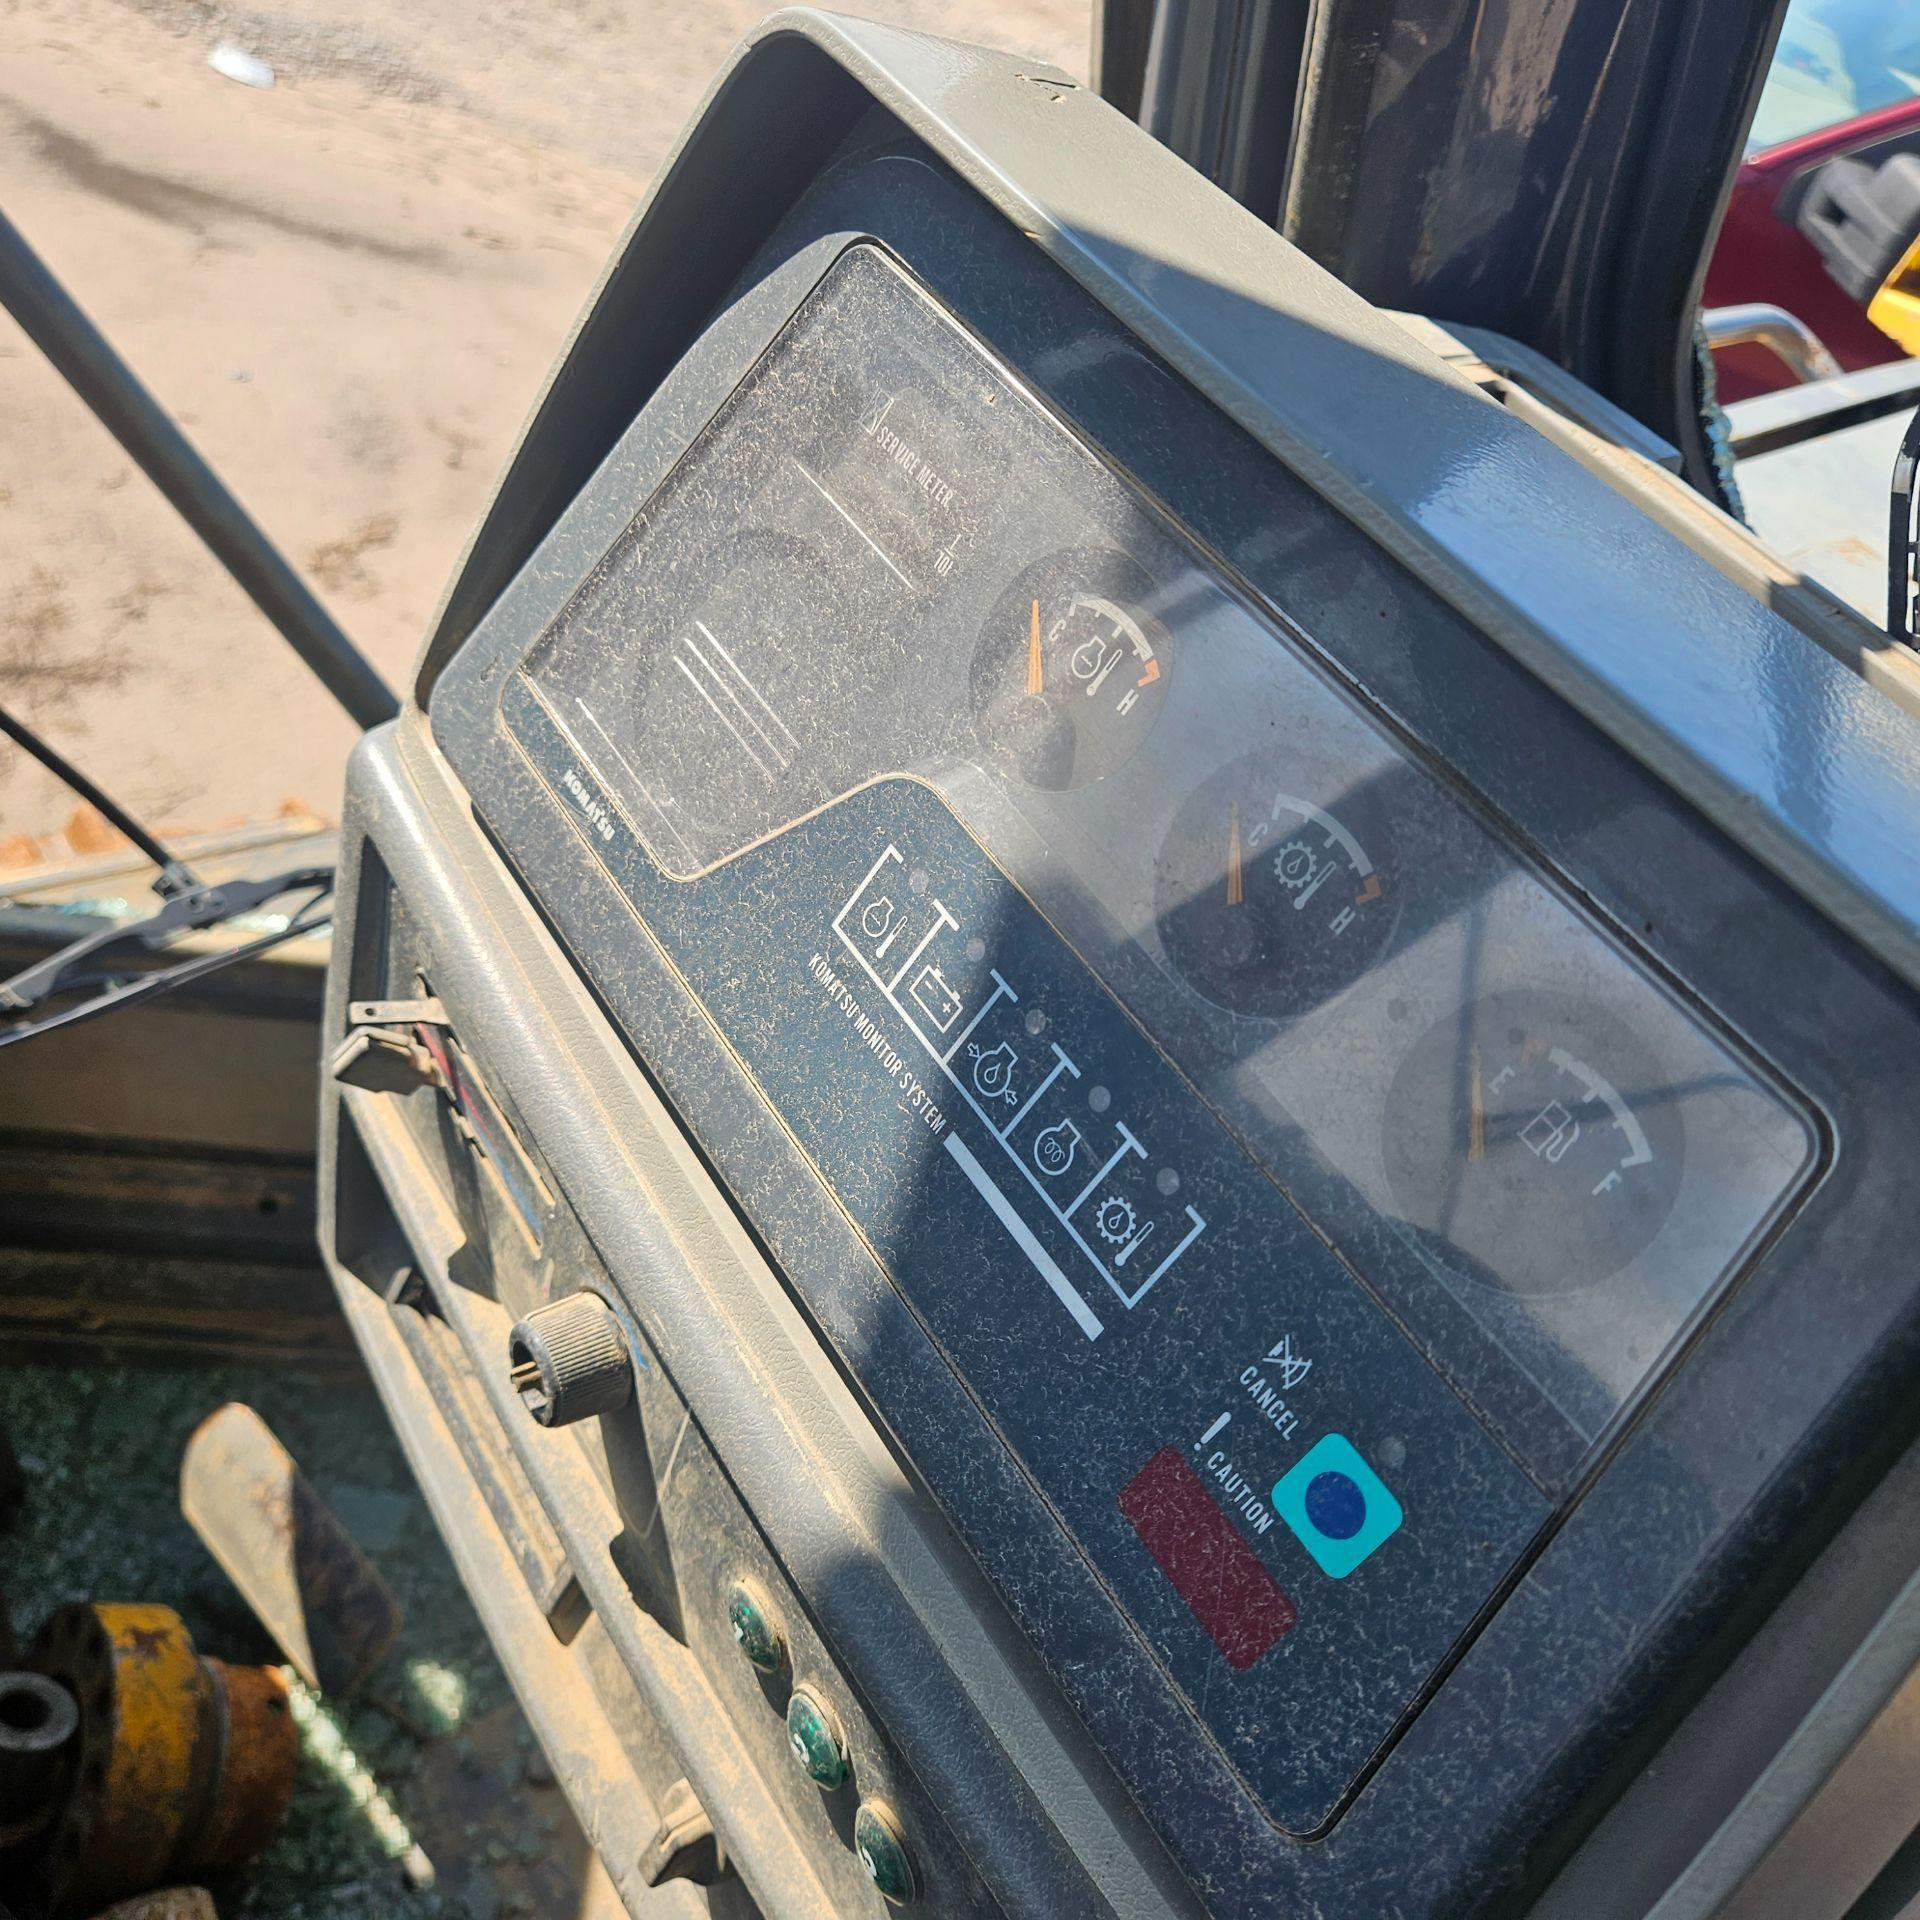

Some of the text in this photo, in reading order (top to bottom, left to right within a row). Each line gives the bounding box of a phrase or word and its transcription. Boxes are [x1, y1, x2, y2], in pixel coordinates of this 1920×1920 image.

[876, 426, 954, 508] SERVICE METER
[1048, 619, 1067, 642] C
[1116, 688, 1140, 716] H
[563, 768, 616, 841] KOMATSU
[1247, 822, 1268, 847] C
[1327, 905, 1357, 936] H
[808, 952, 947, 1135] KOMATSU MONITOR SYSTEM
[1487, 1065, 1516, 1095] E
[1591, 1169, 1622, 1197] F
[1239, 1365, 1299, 1442] CANCEL
[1206, 1450, 1275, 1535] CAUTION
